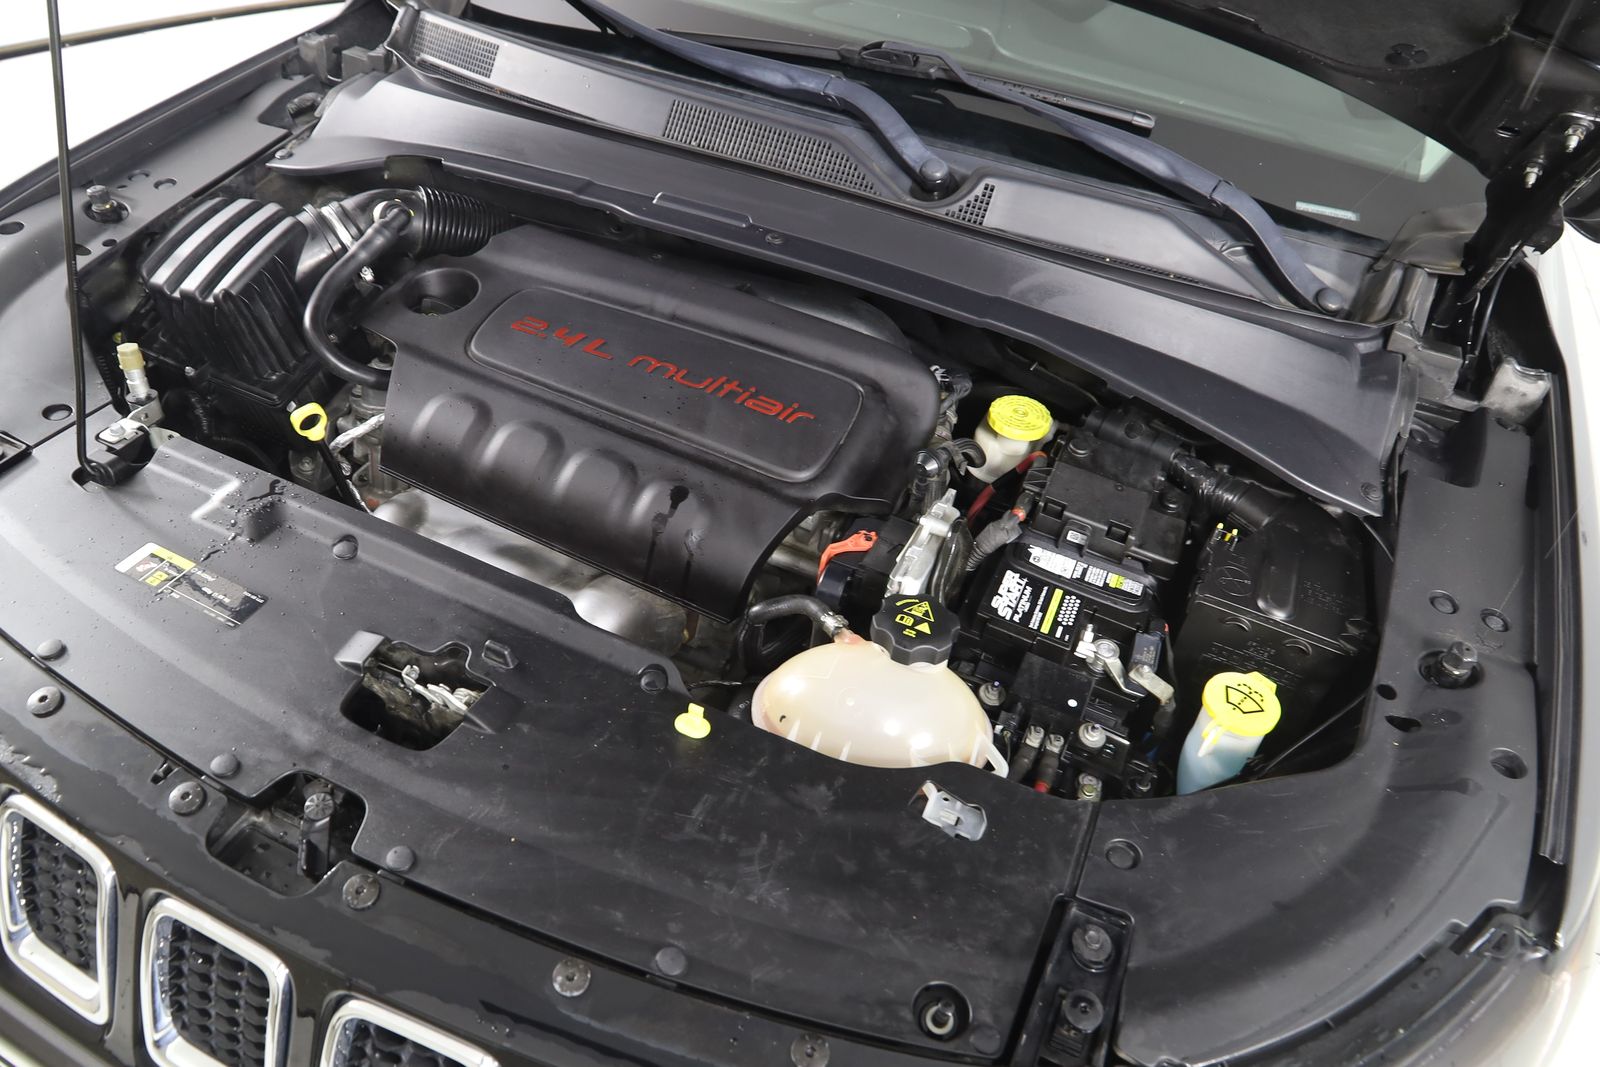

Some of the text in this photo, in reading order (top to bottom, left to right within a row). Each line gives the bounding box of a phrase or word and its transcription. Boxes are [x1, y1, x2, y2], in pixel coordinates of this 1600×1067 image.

[511, 316, 816, 424] 2.4L multiair
[990, 569, 1021, 609] SUPER
[997, 576, 1027, 621] START
[1012, 585, 1033, 623] PLATINUM
